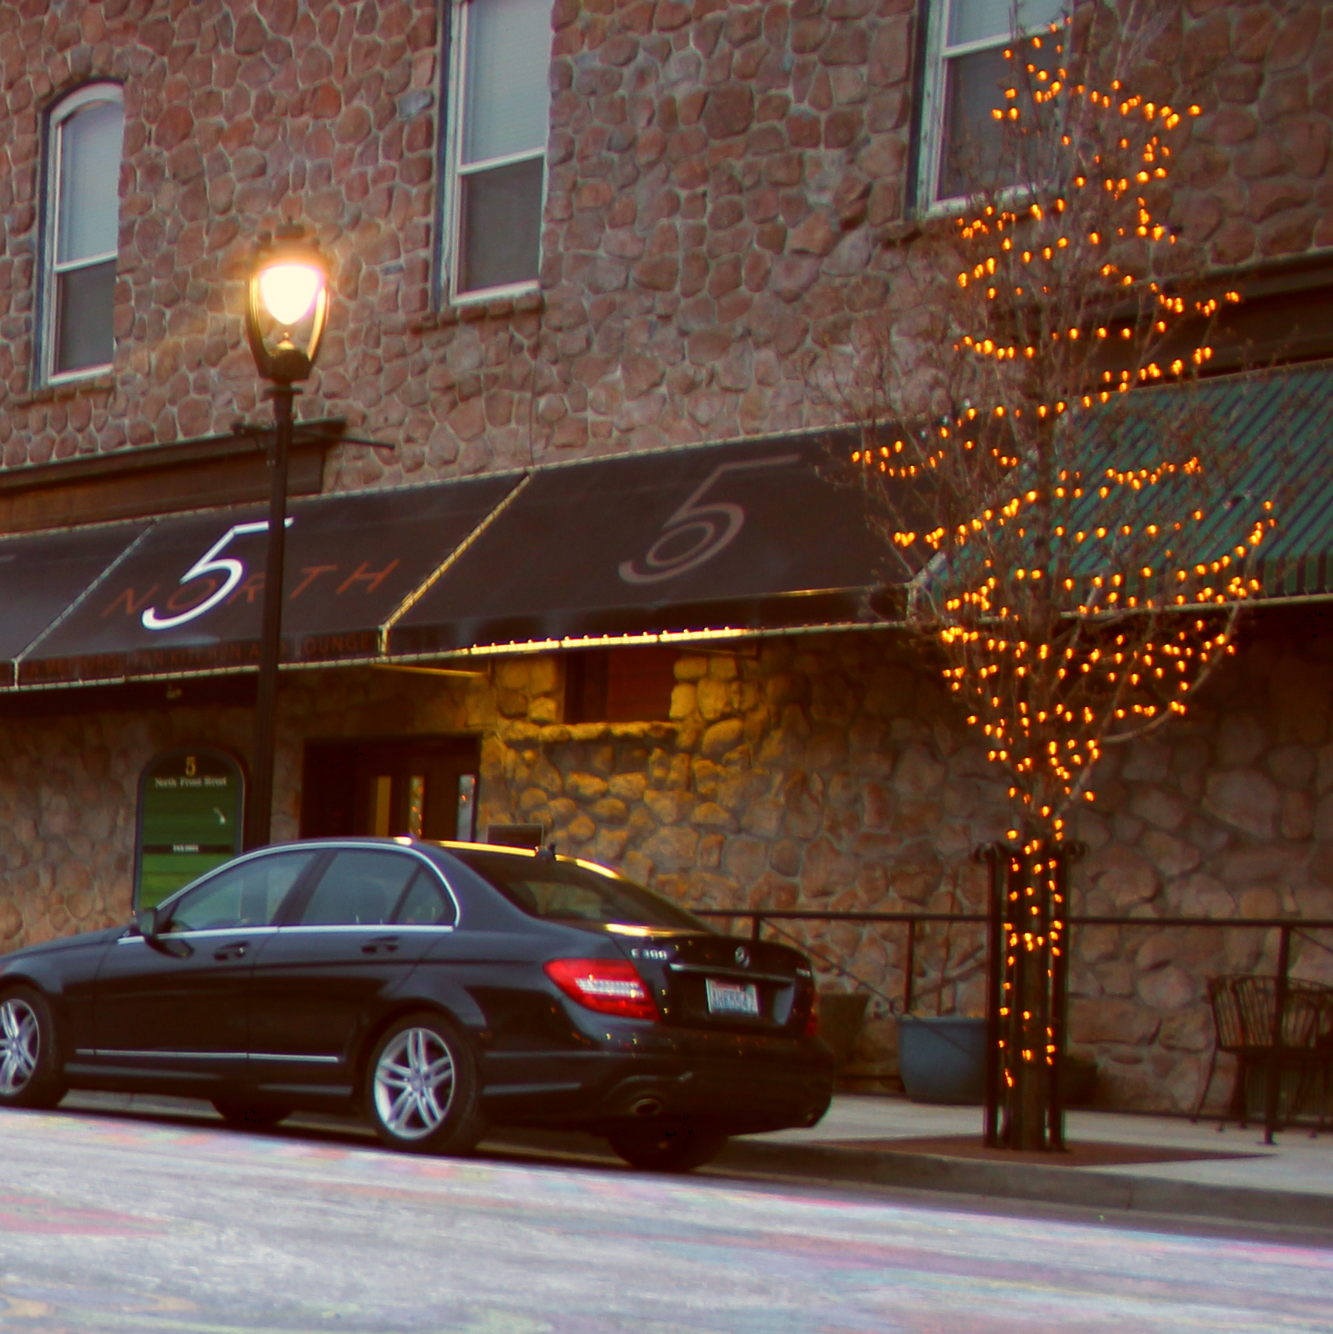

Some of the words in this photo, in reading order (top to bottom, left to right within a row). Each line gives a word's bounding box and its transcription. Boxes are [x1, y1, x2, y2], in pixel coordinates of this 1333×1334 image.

[618, 453, 801, 584] 5
[101, 558, 401, 618] NORTH
[141, 516, 294, 630] 5
[249, 641, 288, 657] AD
[185, 756, 196, 776] 5
